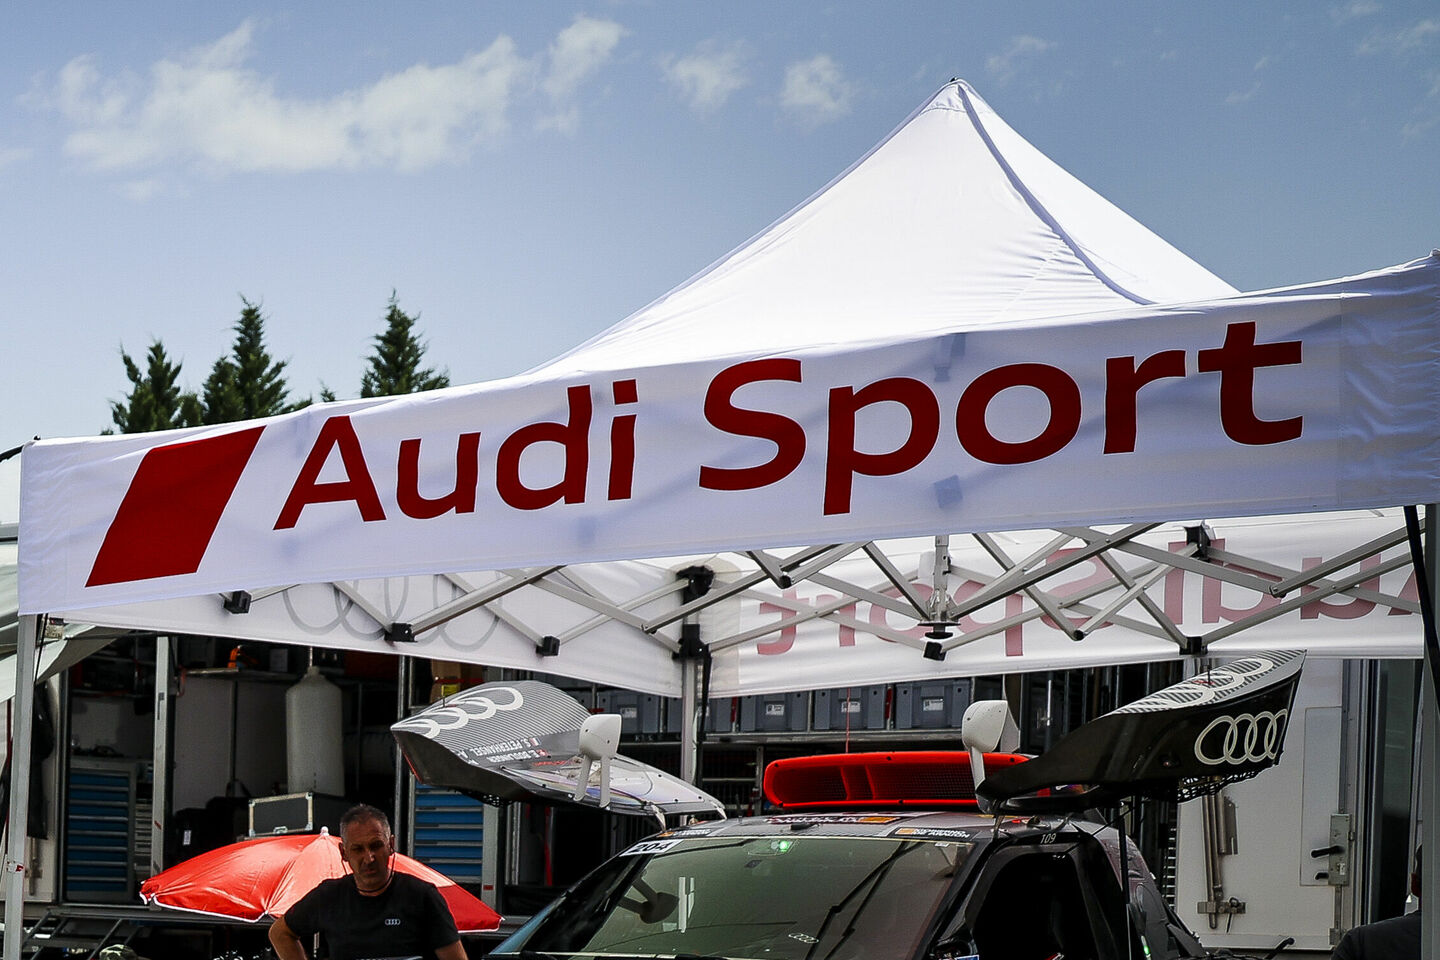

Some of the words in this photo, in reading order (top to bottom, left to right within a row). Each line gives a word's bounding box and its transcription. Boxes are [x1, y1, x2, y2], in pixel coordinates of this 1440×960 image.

[272, 378, 639, 532] Audi
[697, 321, 1306, 517] Sport
[1040, 832, 1056, 844] 109
